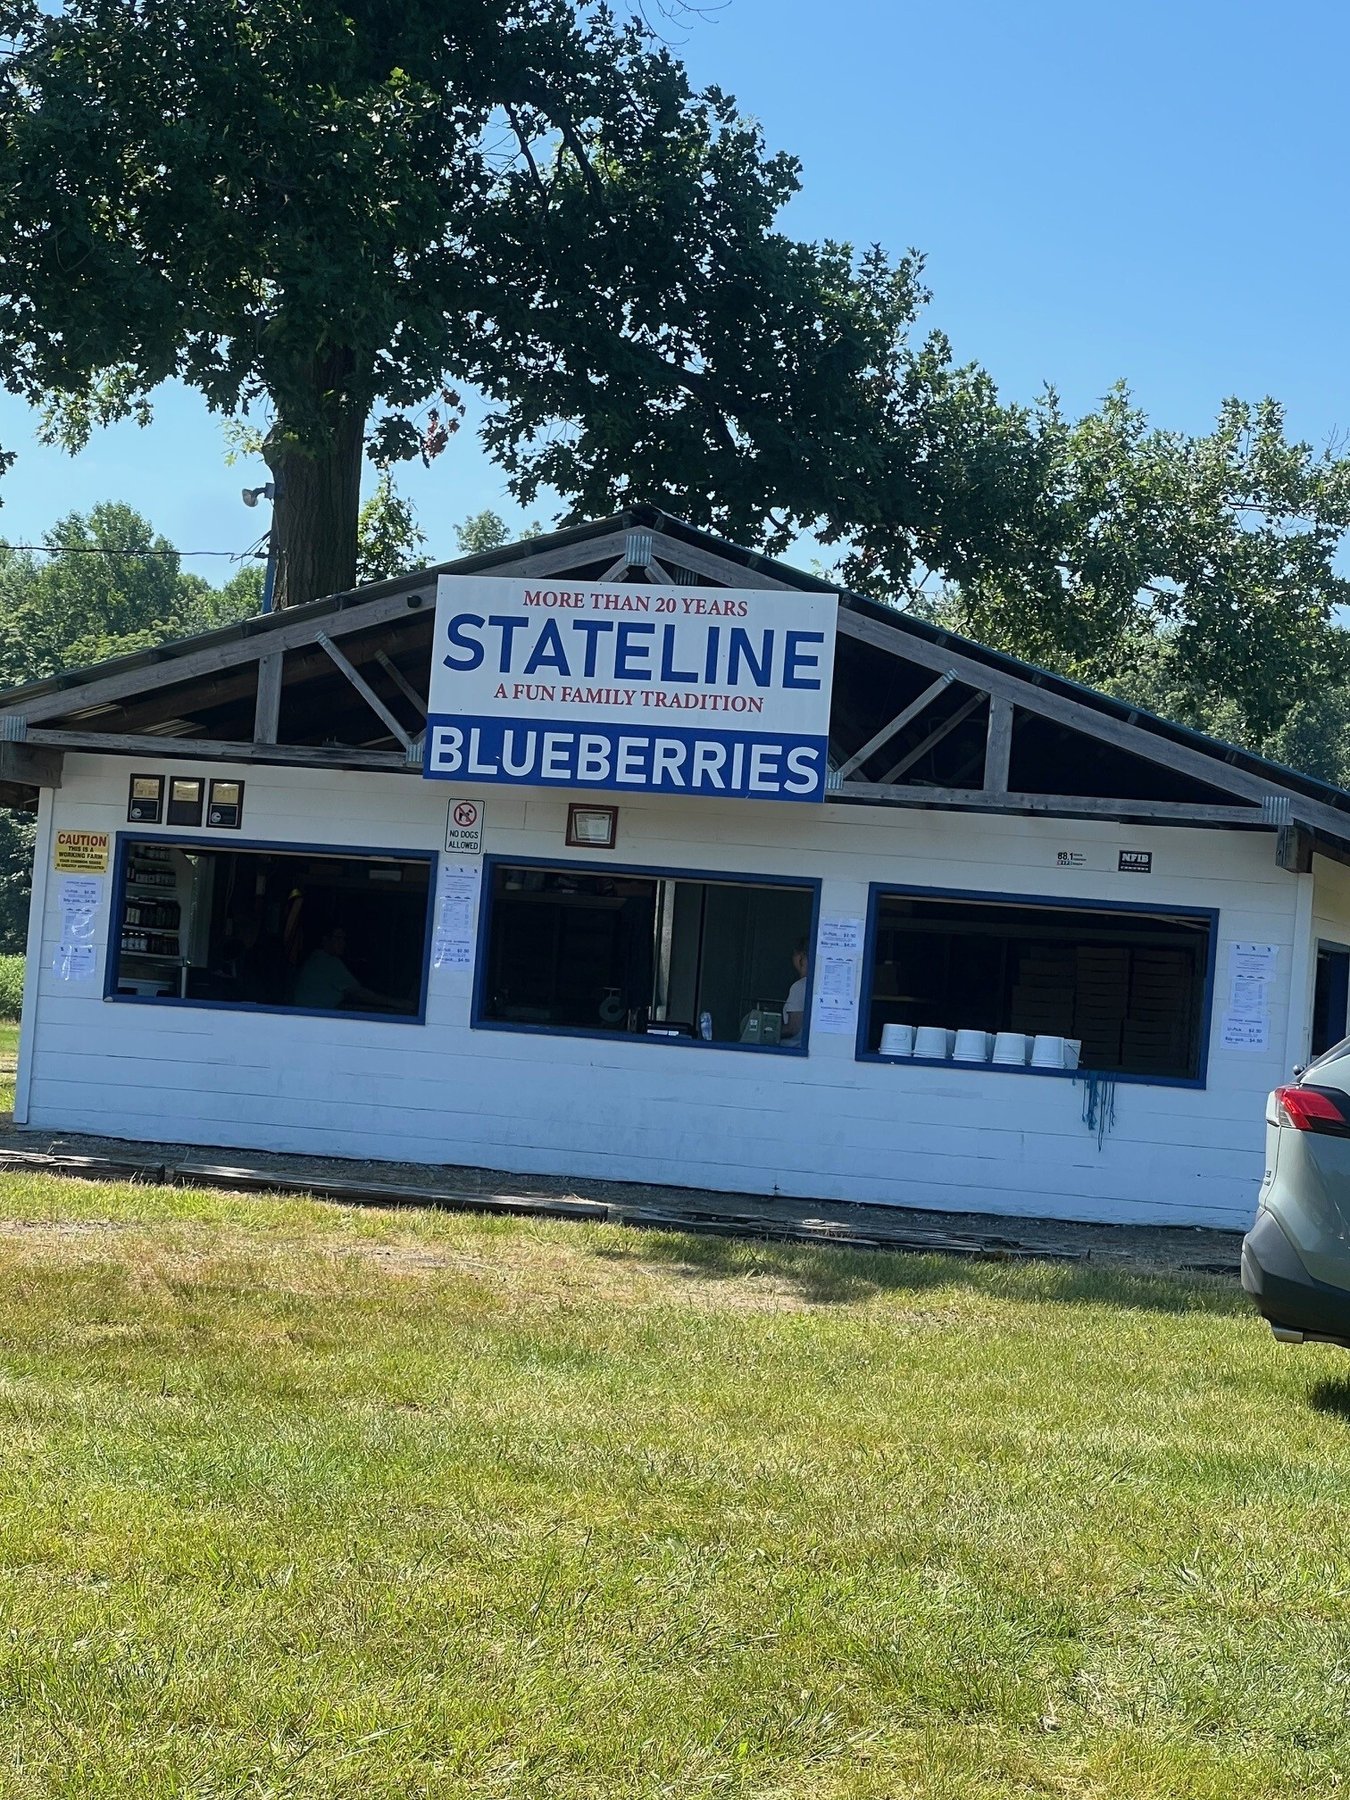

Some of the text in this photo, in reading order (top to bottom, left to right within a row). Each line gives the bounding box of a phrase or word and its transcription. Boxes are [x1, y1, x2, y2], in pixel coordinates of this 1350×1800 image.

[523, 590, 748, 617] MORE THAN 20 YEARS
[442, 613, 826, 690] STATELINE
[493, 683, 764, 713] A FUN FAMILY TRADITION
[429, 725, 820, 794] BLUEBERRIES
[58, 833, 106, 846] CAUTION
[449, 830, 479, 839] NO DOGS
[448, 841, 479, 850] ALLOWED
[1057, 851, 1073, 861] 88.1
[1122, 853, 1148, 862] NFIB
